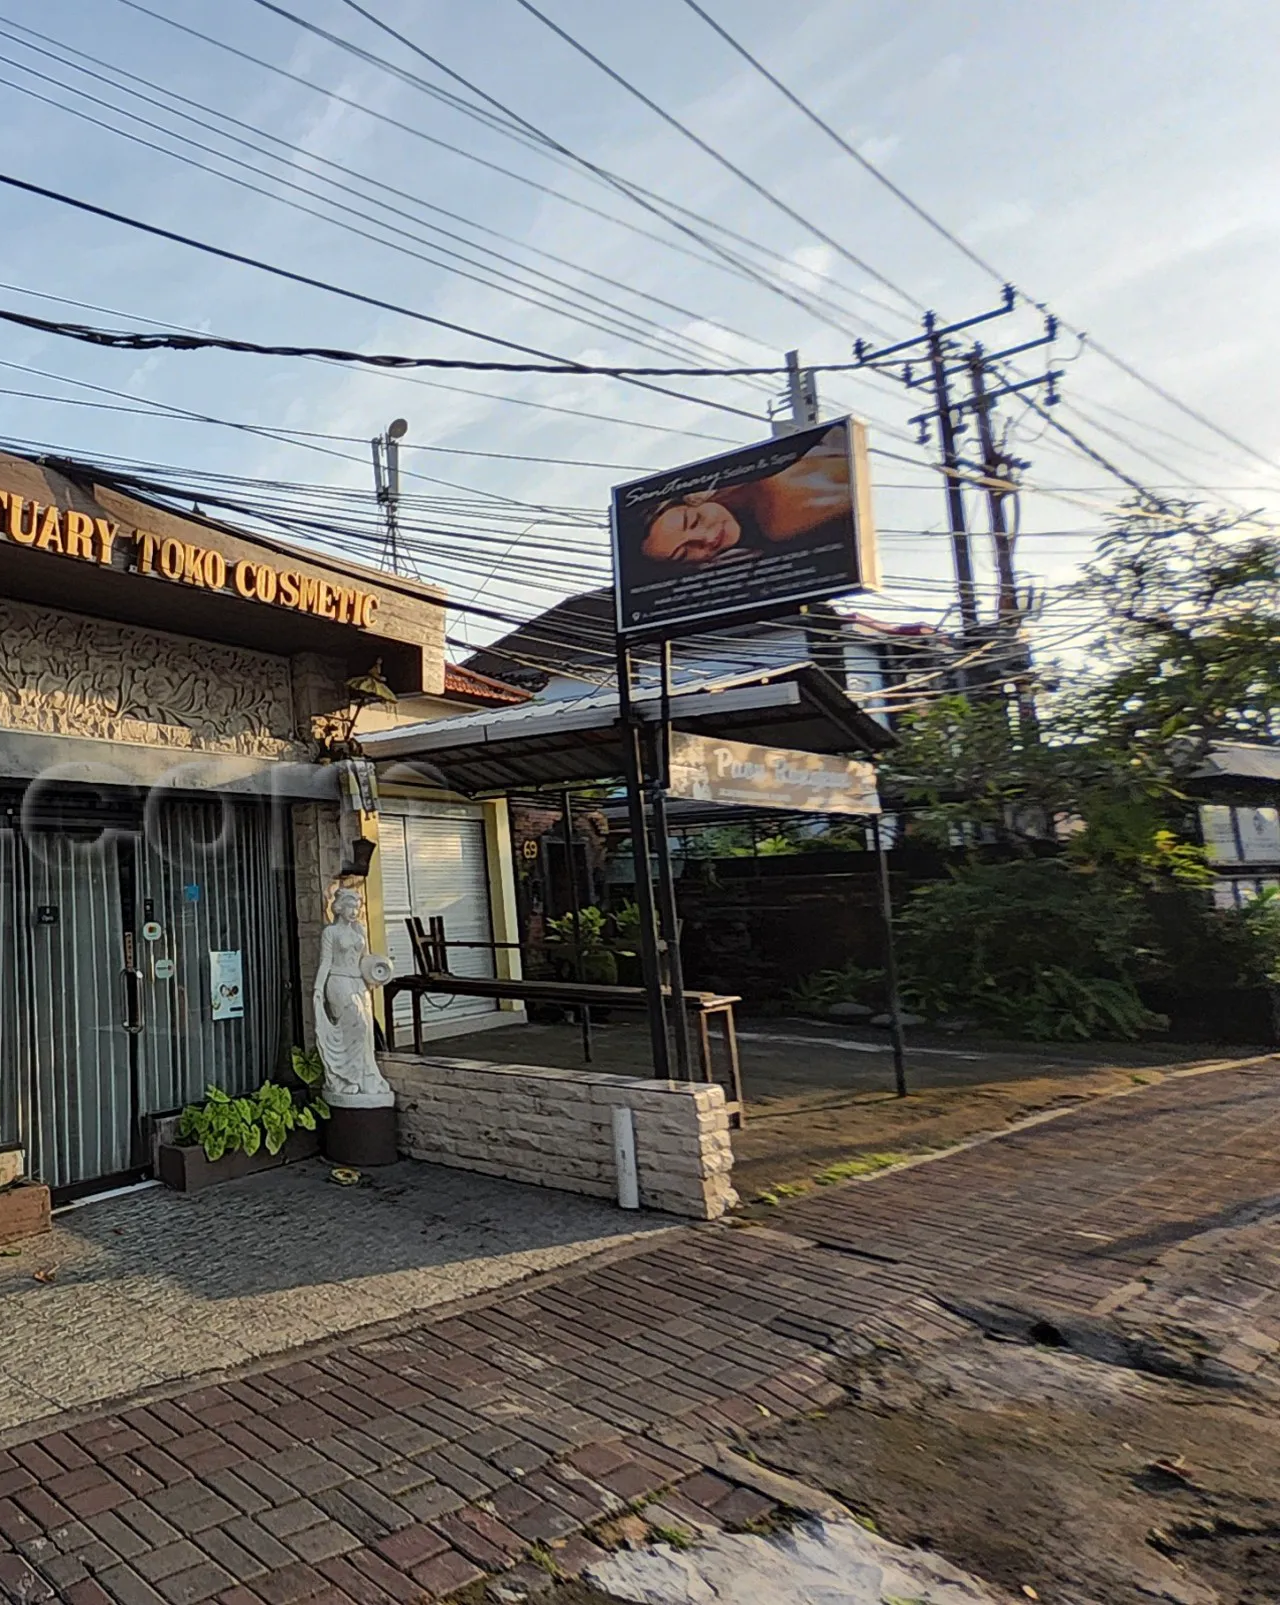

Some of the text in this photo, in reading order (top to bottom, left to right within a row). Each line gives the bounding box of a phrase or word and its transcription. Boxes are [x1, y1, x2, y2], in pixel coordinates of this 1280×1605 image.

[130, 529, 226, 589] TOKO
[235, 559, 380, 628] COSMETIC
[523, 840, 538, 859] 69
